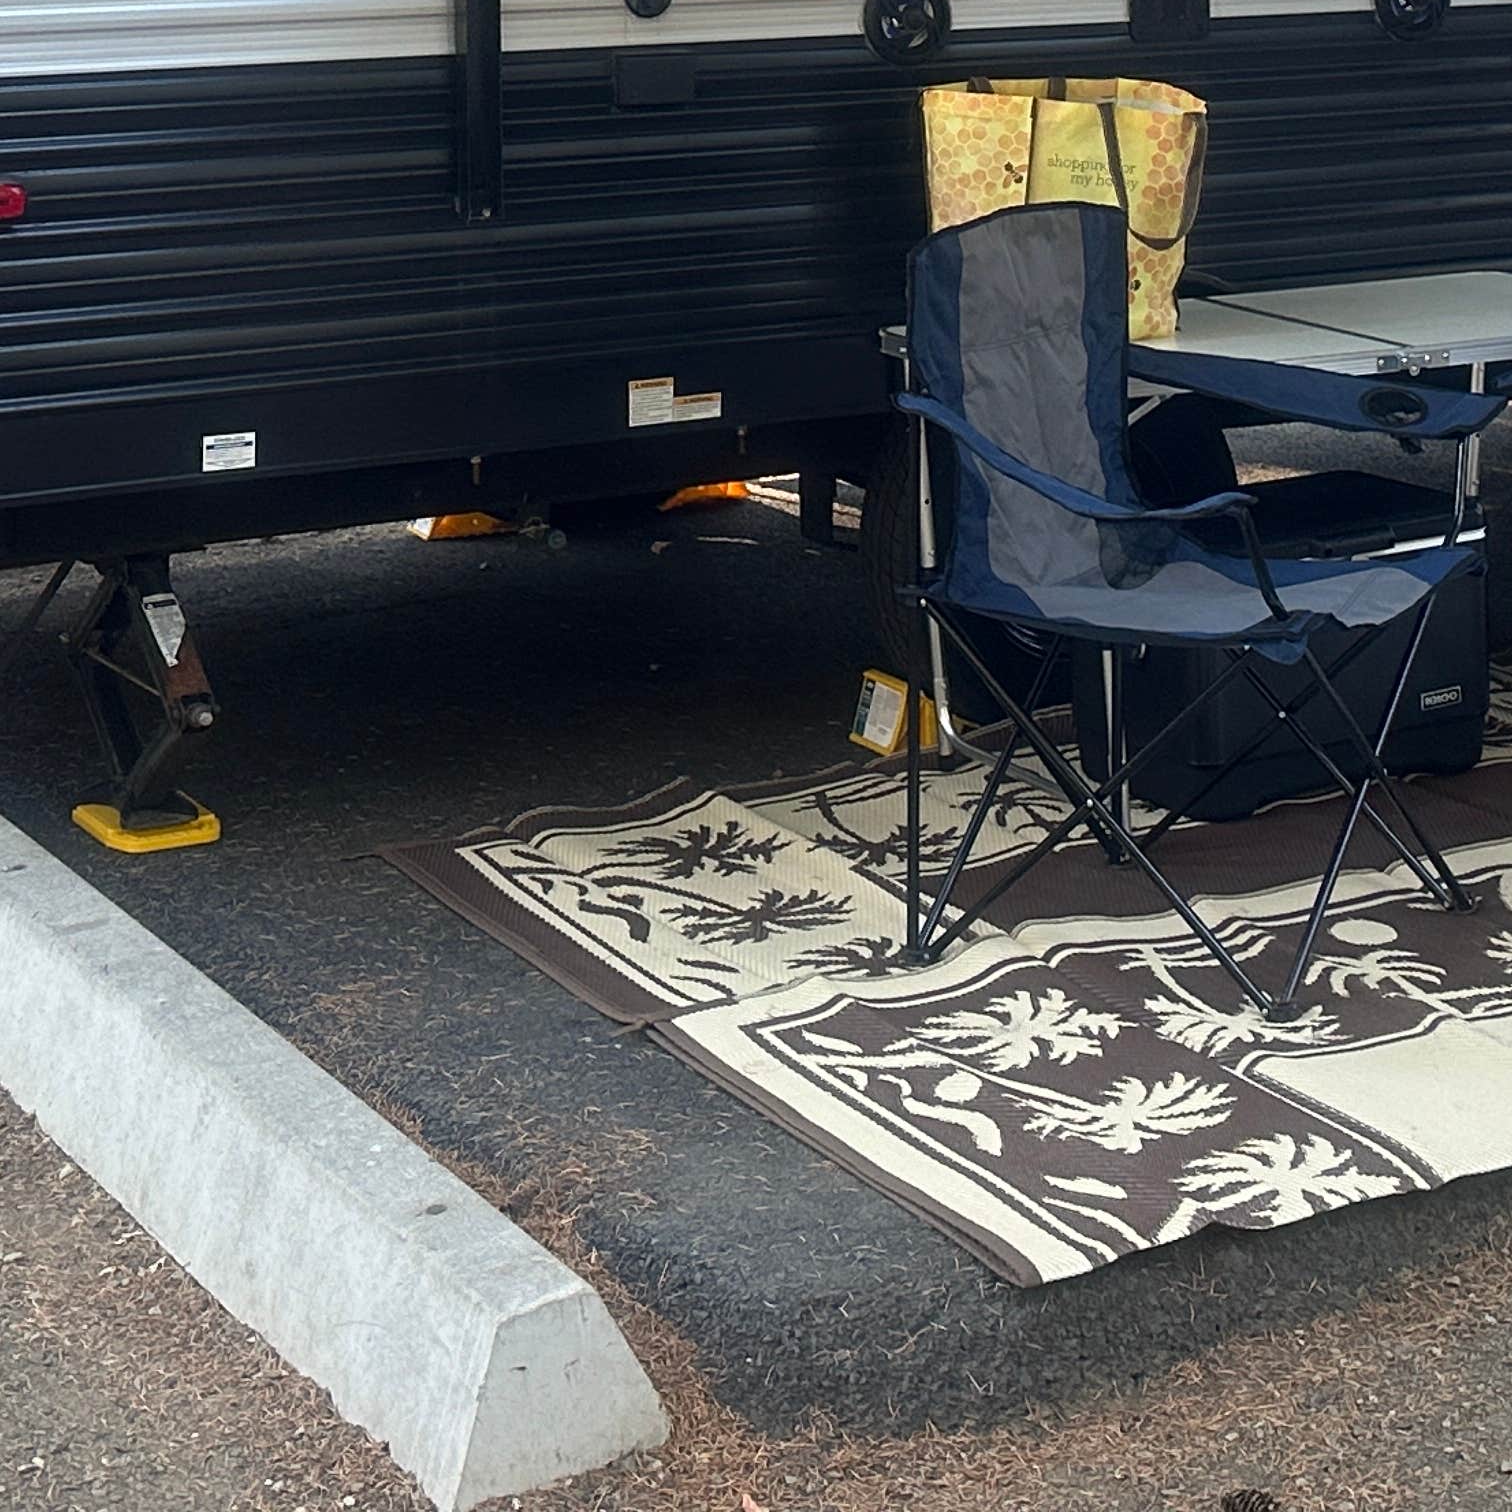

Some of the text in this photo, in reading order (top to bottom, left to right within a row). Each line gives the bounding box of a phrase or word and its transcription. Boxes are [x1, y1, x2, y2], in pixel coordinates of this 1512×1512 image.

[1119, 157, 1136, 174] or
[1070, 173, 1139, 192] my hoy
